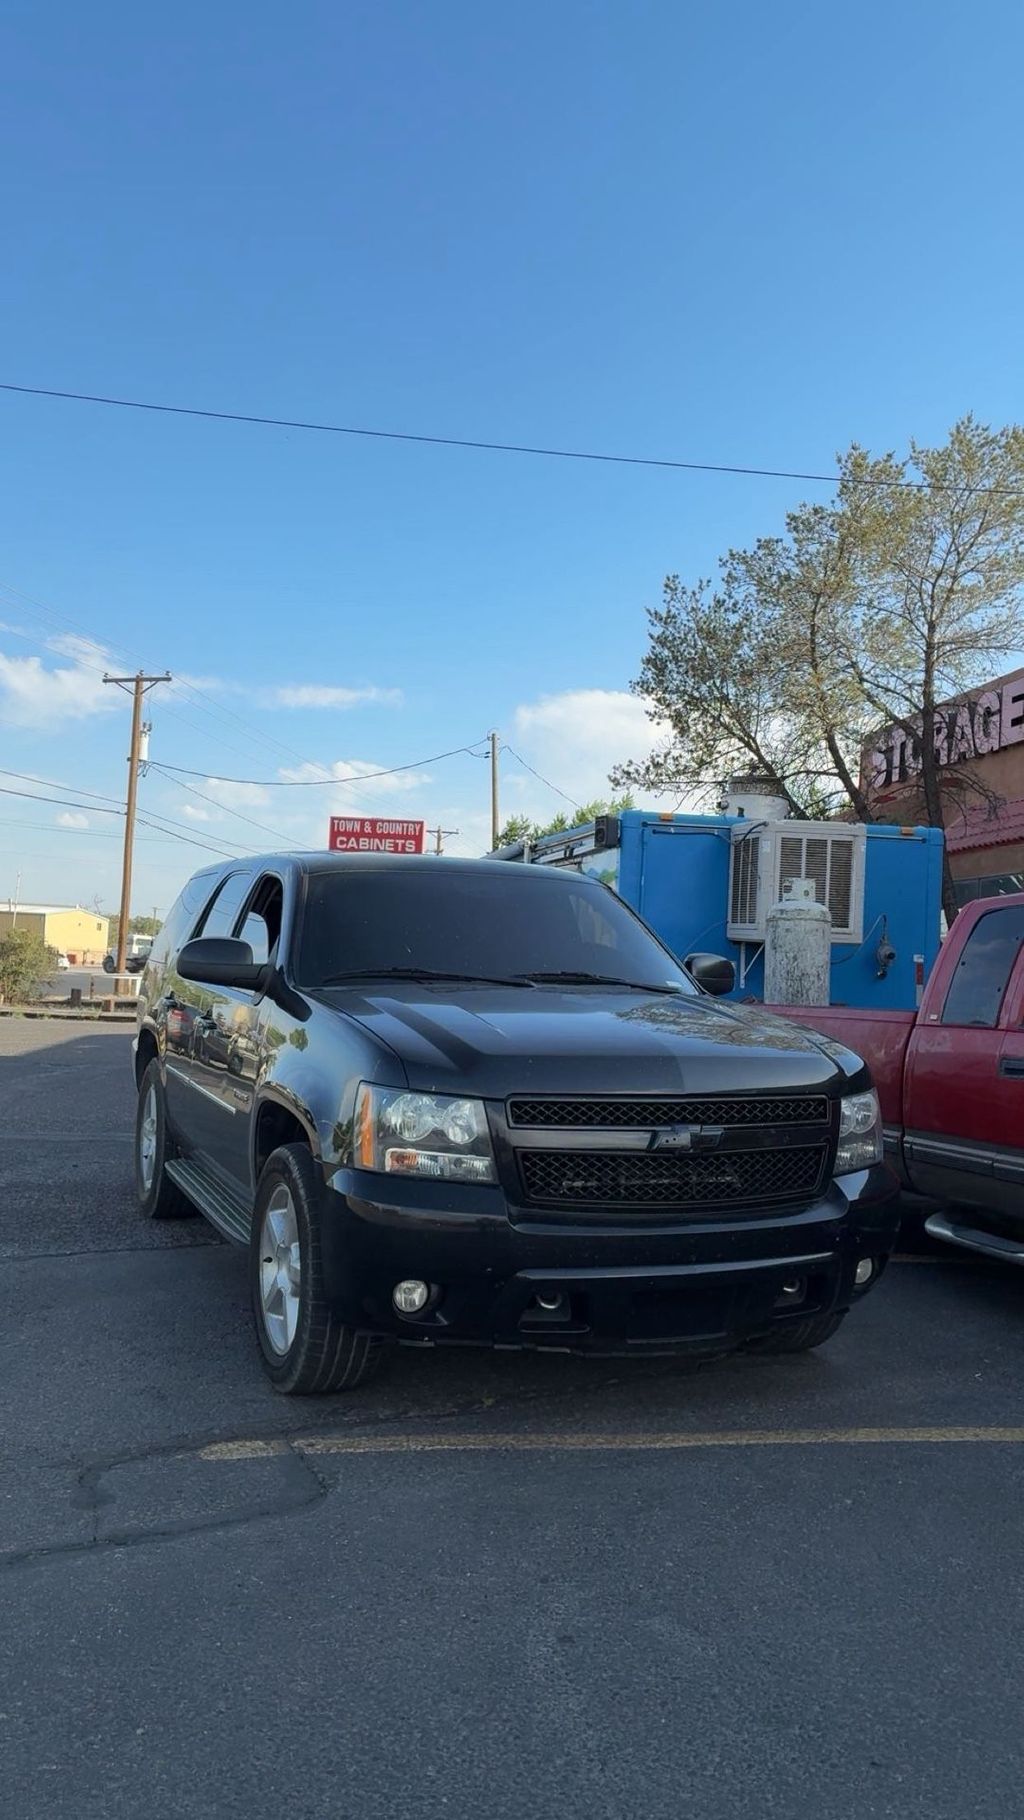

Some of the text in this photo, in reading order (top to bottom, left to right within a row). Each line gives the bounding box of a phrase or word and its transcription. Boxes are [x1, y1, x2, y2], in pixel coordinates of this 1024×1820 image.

[333, 820, 421, 836] TOWN & COUNTRY
[336, 836, 416, 852] CABINETS
